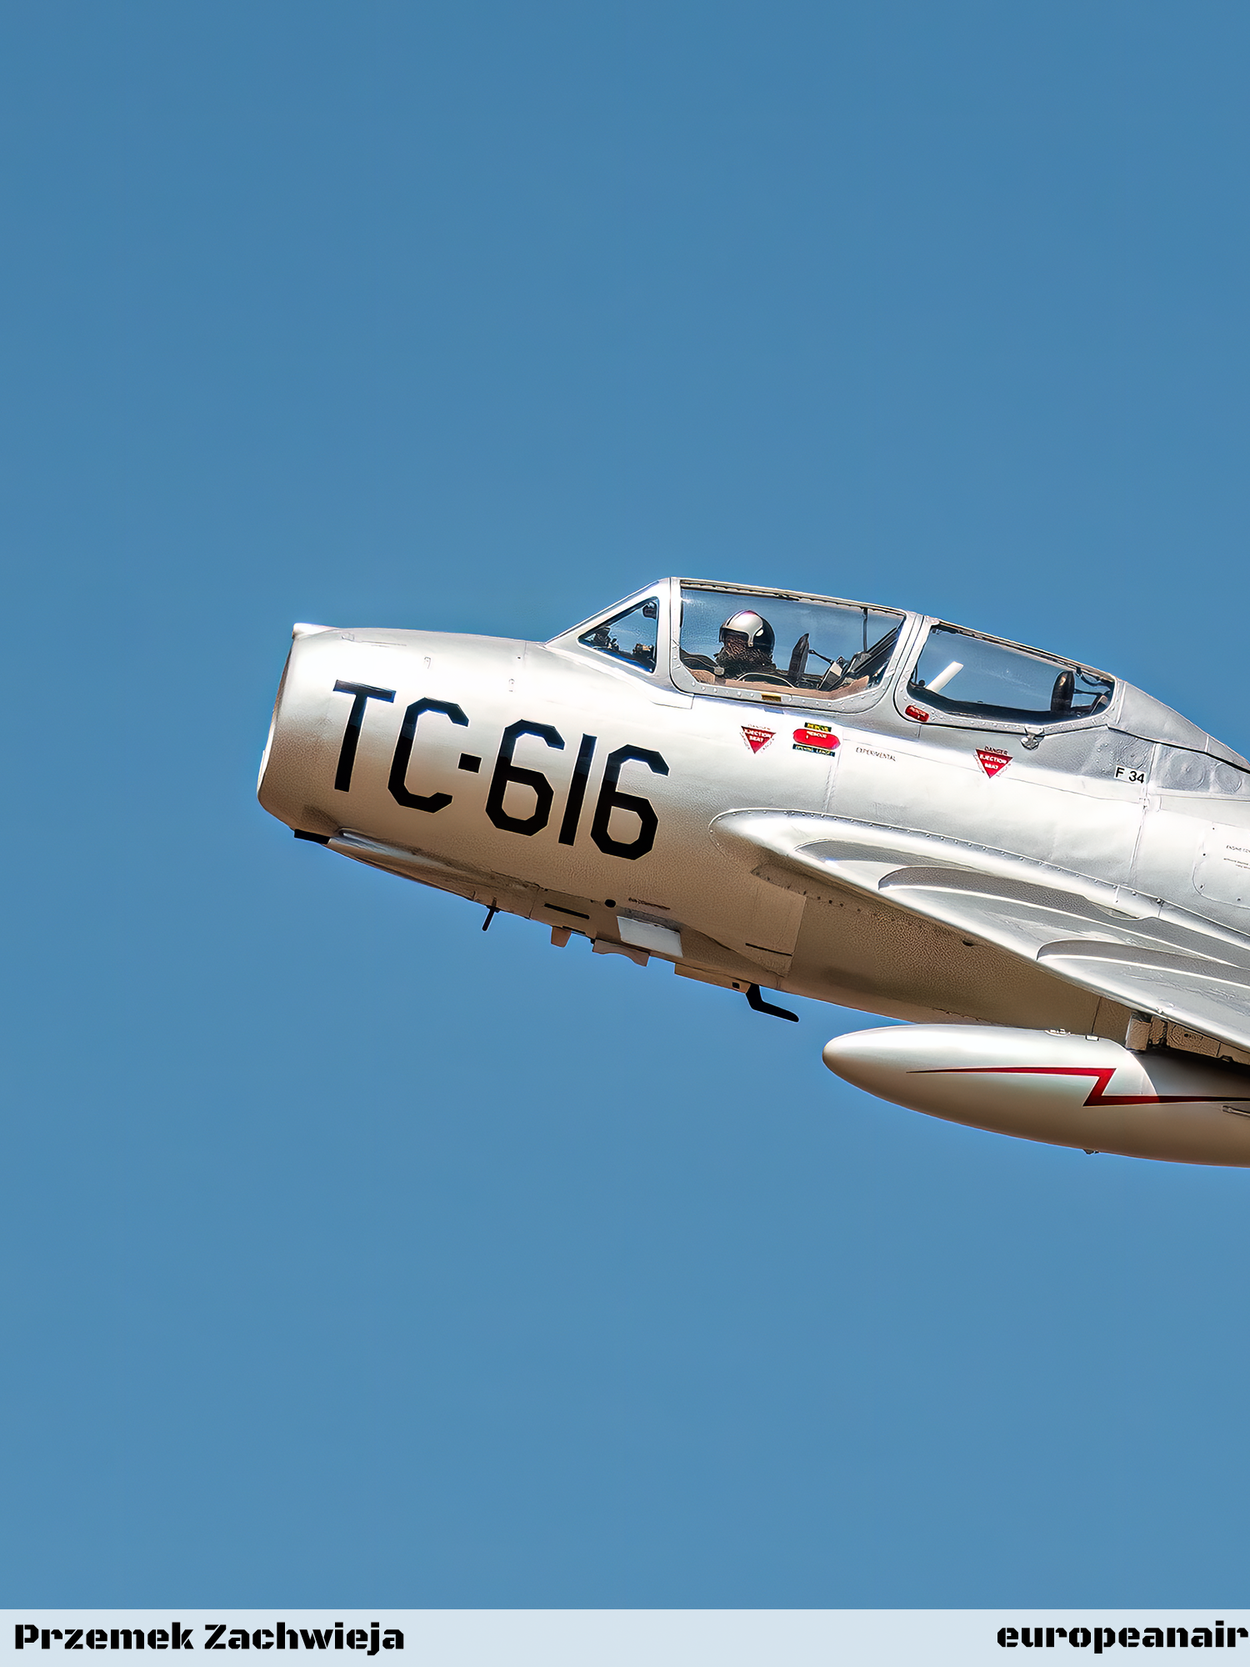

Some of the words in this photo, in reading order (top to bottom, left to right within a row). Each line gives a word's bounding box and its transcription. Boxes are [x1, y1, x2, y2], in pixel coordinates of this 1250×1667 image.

[984, 745, 1009, 756] DANGER
[333, 680, 670, 861] TC-616
[1115, 766, 1125, 778] F
[1128, 770, 1146, 784] 34
